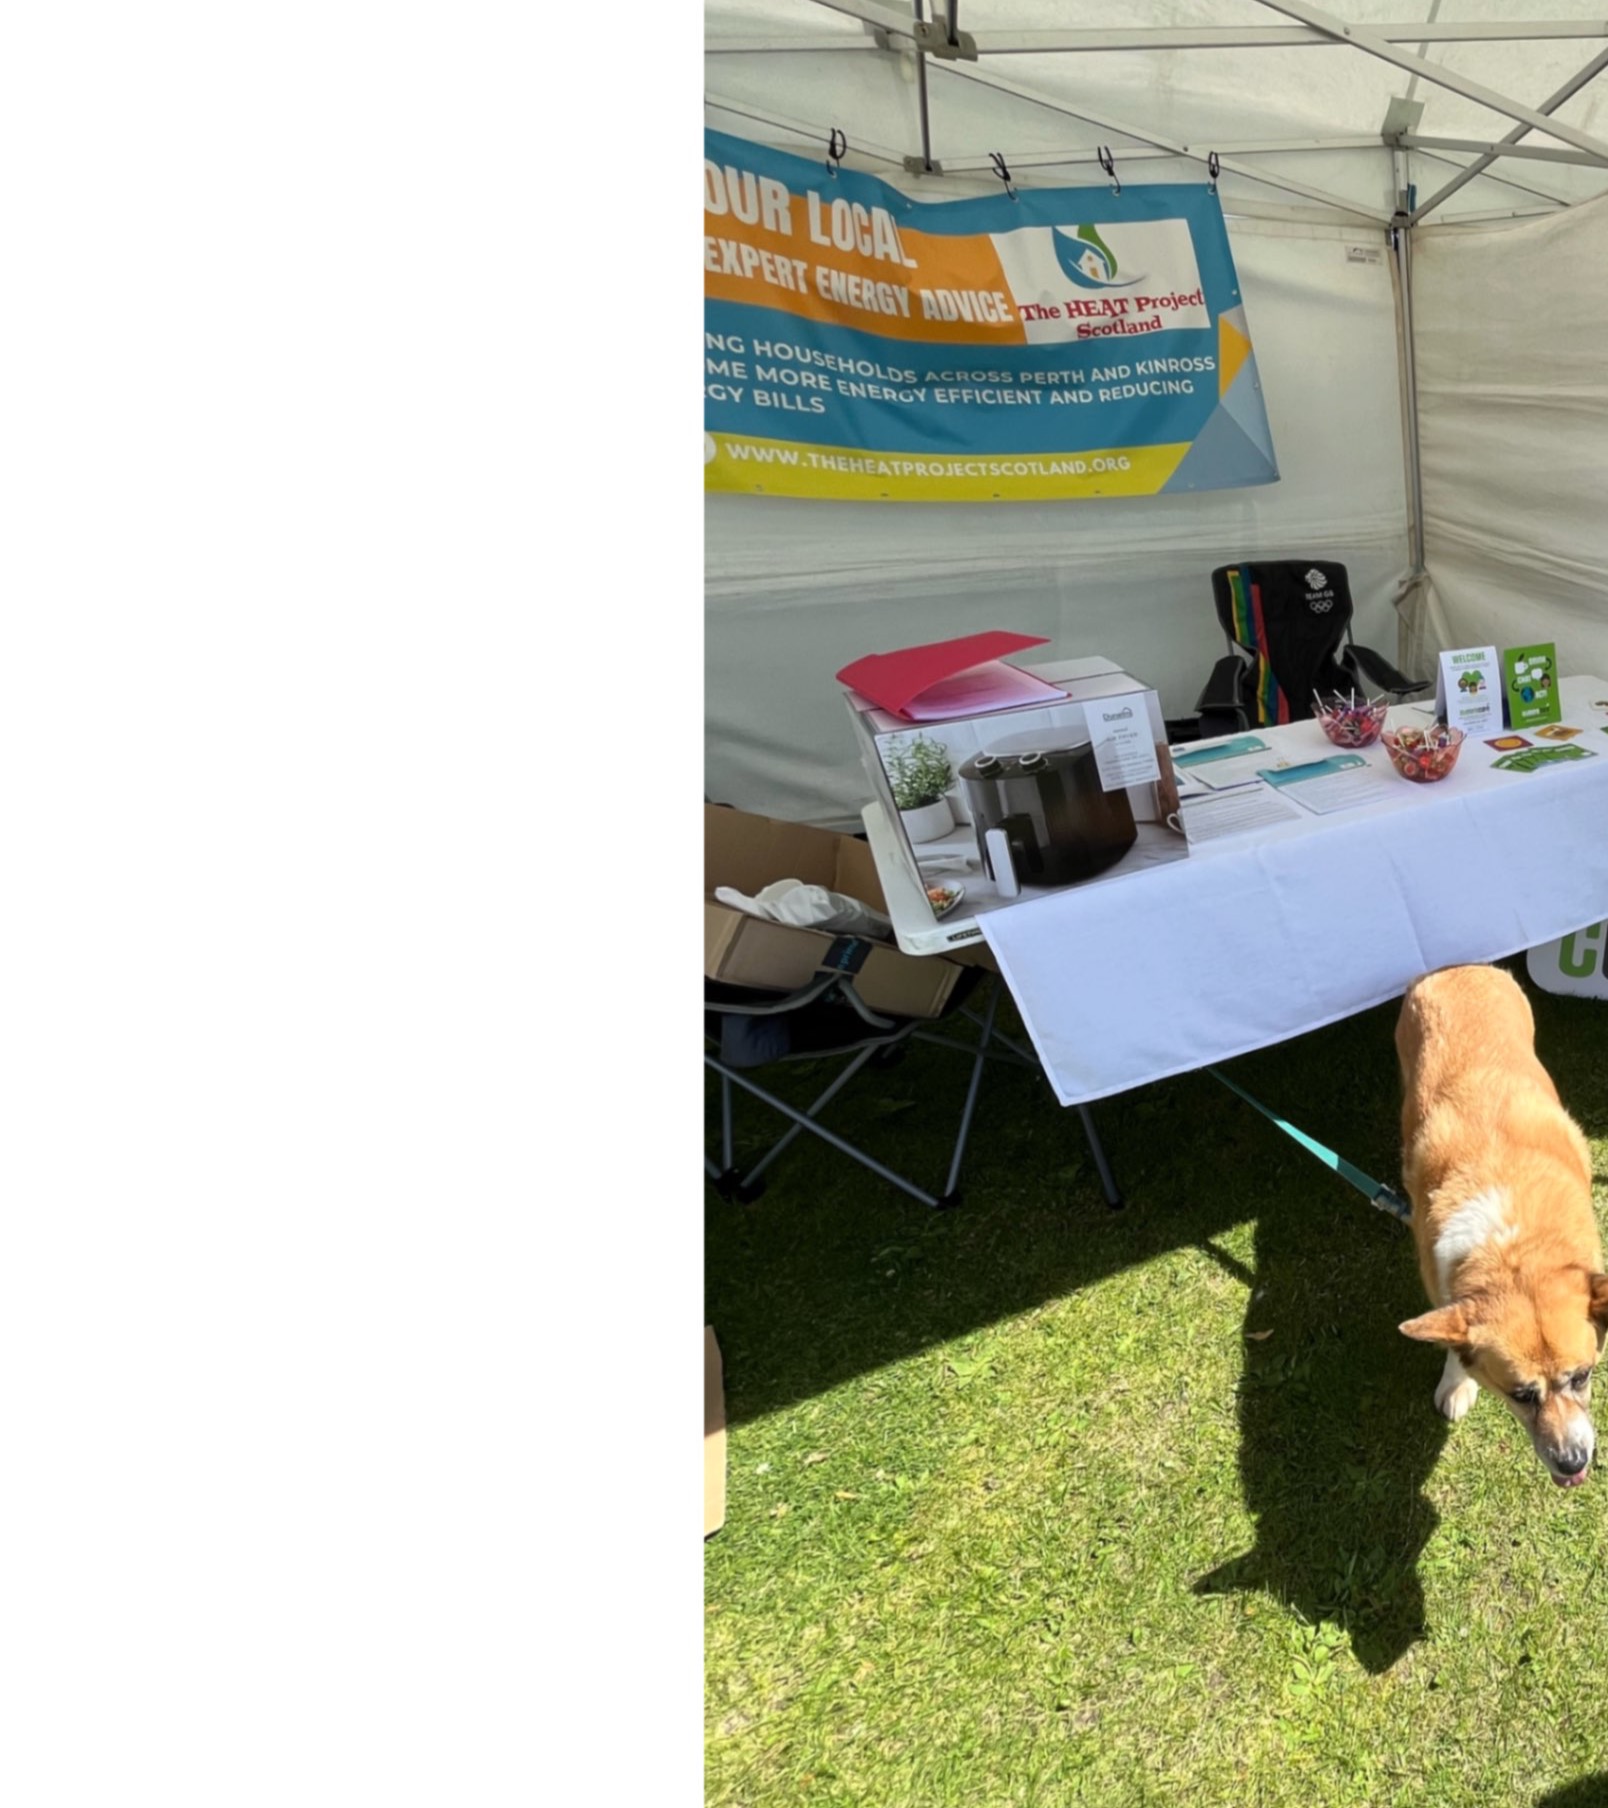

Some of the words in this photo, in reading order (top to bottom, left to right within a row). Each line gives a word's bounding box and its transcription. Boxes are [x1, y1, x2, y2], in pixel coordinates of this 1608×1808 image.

[704, 158, 792, 236] OUR
[807, 190, 918, 269] LOCAL
[704, 235, 808, 293] EXPERT
[815, 266, 911, 318] ENERGY
[920, 288, 1014, 323] ADVICE
[1017, 303, 1061, 322] The
[1064, 298, 1129, 320] HEAT
[1134, 288, 1204, 313] Project
[1076, 316, 1163, 339] Scotland
[753, 339, 918, 385] HOUSEHOLDS
[925, 369, 1013, 384] ACROSS
[1019, 370, 1086, 385] PERTH
[1091, 365, 1131, 383] AND
[1135, 356, 1216, 377] KINROSS
[753, 388, 826, 414] BILLS
[755, 365, 833, 392] MORE
[836, 379, 927, 403] ENERGY
[934, 387, 1043, 405] EFFICIENT
[1050, 388, 1094, 405] AND
[1099, 379, 1195, 403] REDUCING
[725, 443, 1131, 477] WWW.THEHEATPROJECTSCOTLAND.ORG
[1451, 651, 1486, 664] WELCOME
